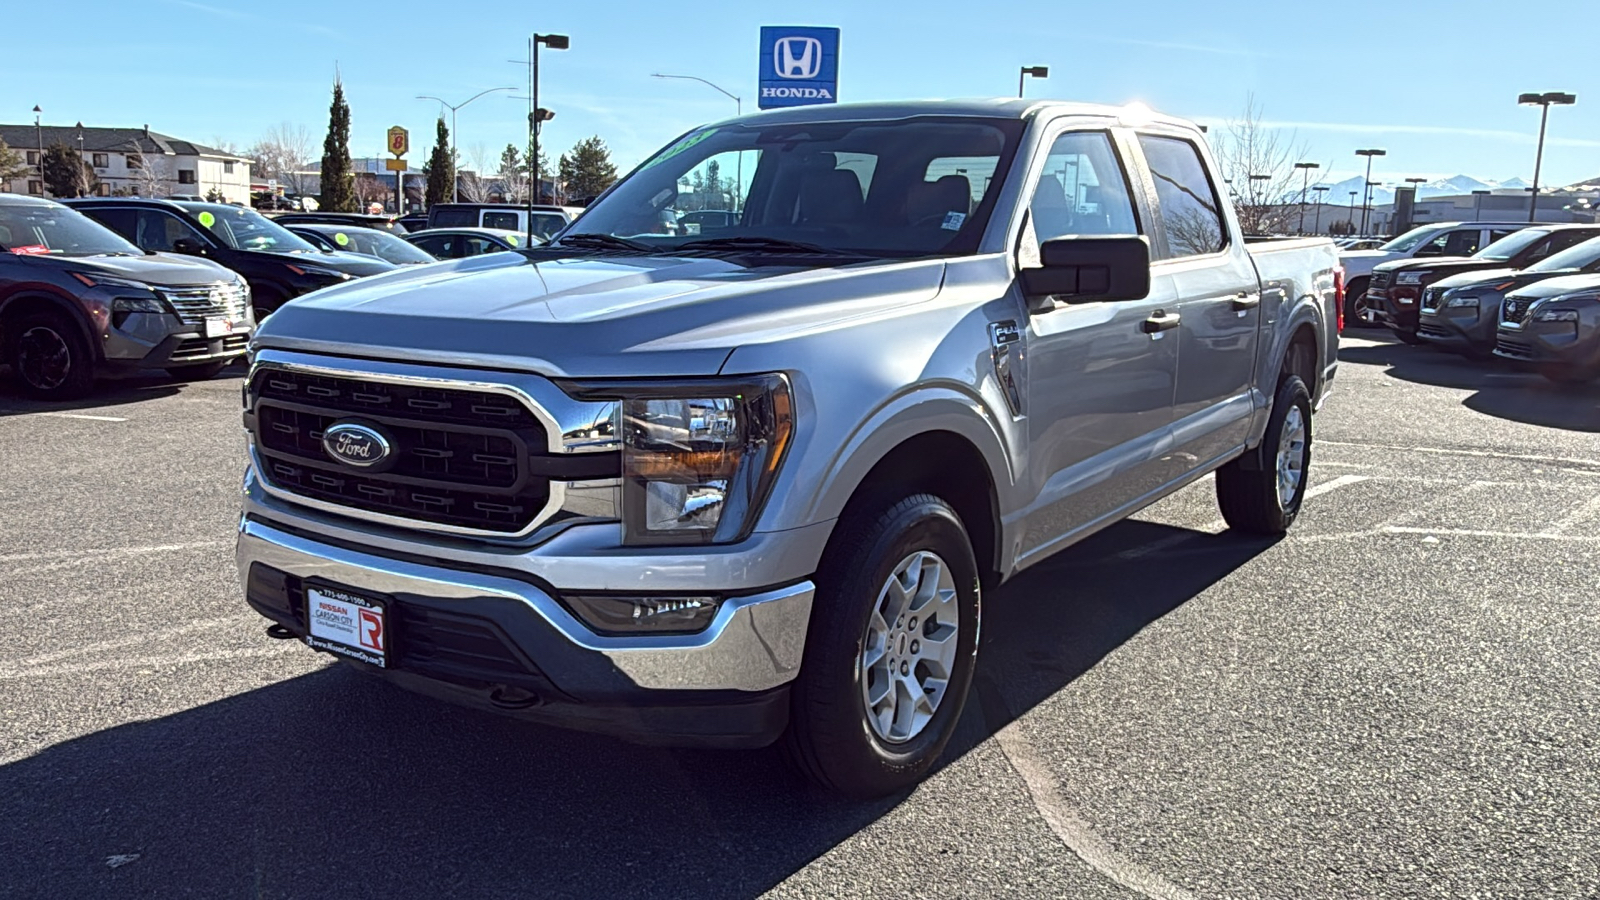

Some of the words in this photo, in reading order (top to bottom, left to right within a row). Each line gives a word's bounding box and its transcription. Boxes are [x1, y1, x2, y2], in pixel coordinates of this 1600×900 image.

[762, 87, 833, 99] HONDA
[392, 135, 404, 150] 8
[336, 432, 371, 458] Ford
[319, 602, 348, 615] NISSAN
[315, 609, 340, 622] CARSON
[341, 616, 354, 626] CITY
